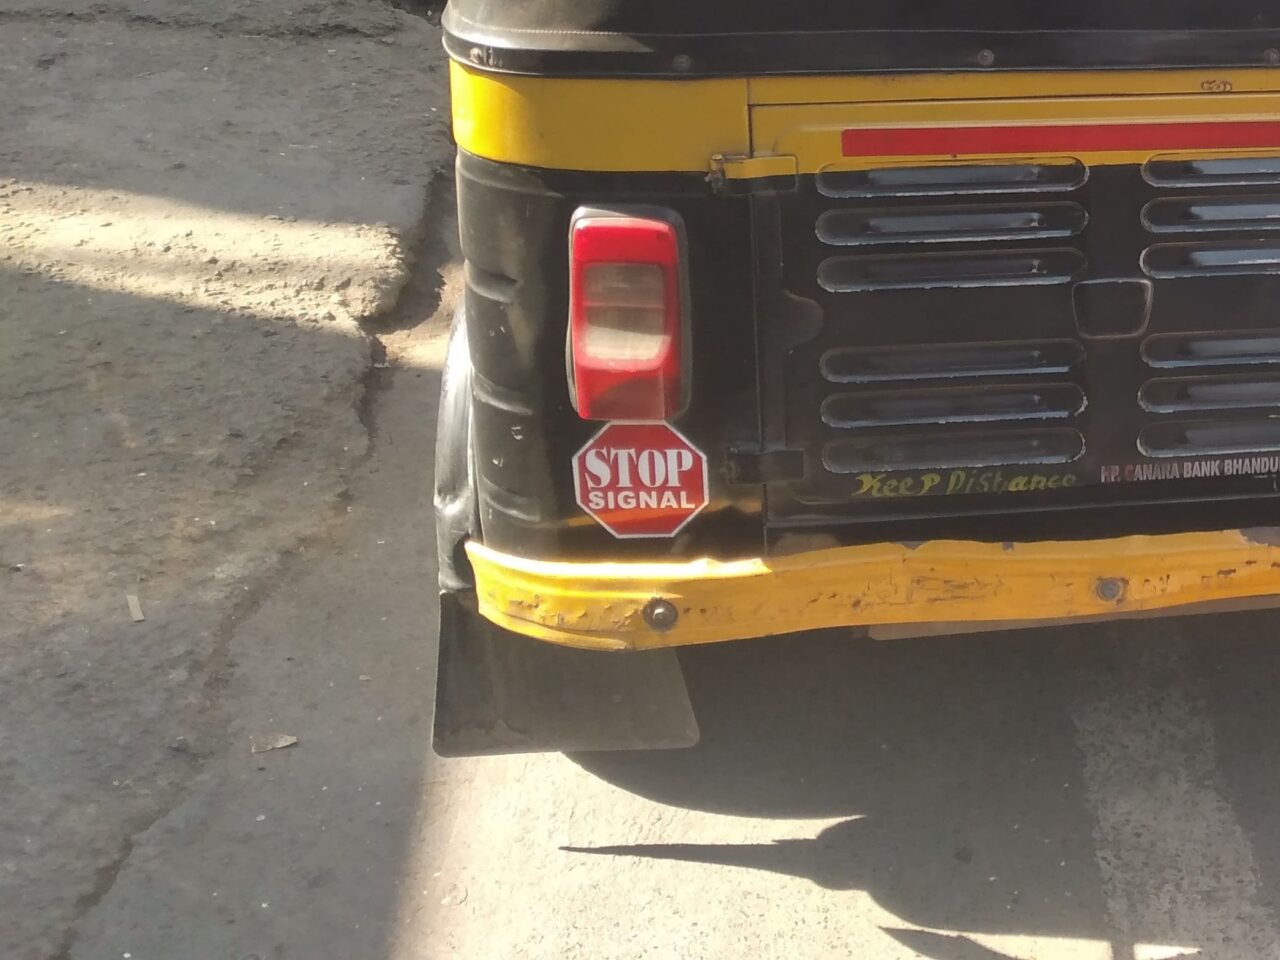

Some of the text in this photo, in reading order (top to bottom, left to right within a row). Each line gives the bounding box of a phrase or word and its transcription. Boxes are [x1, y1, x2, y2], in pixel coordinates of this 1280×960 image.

[584, 445, 694, 490] STOP
[1124, 462, 1180, 482] CANARA
[1183, 460, 1221, 479] BANK
[588, 490, 696, 510] SIGNAL
